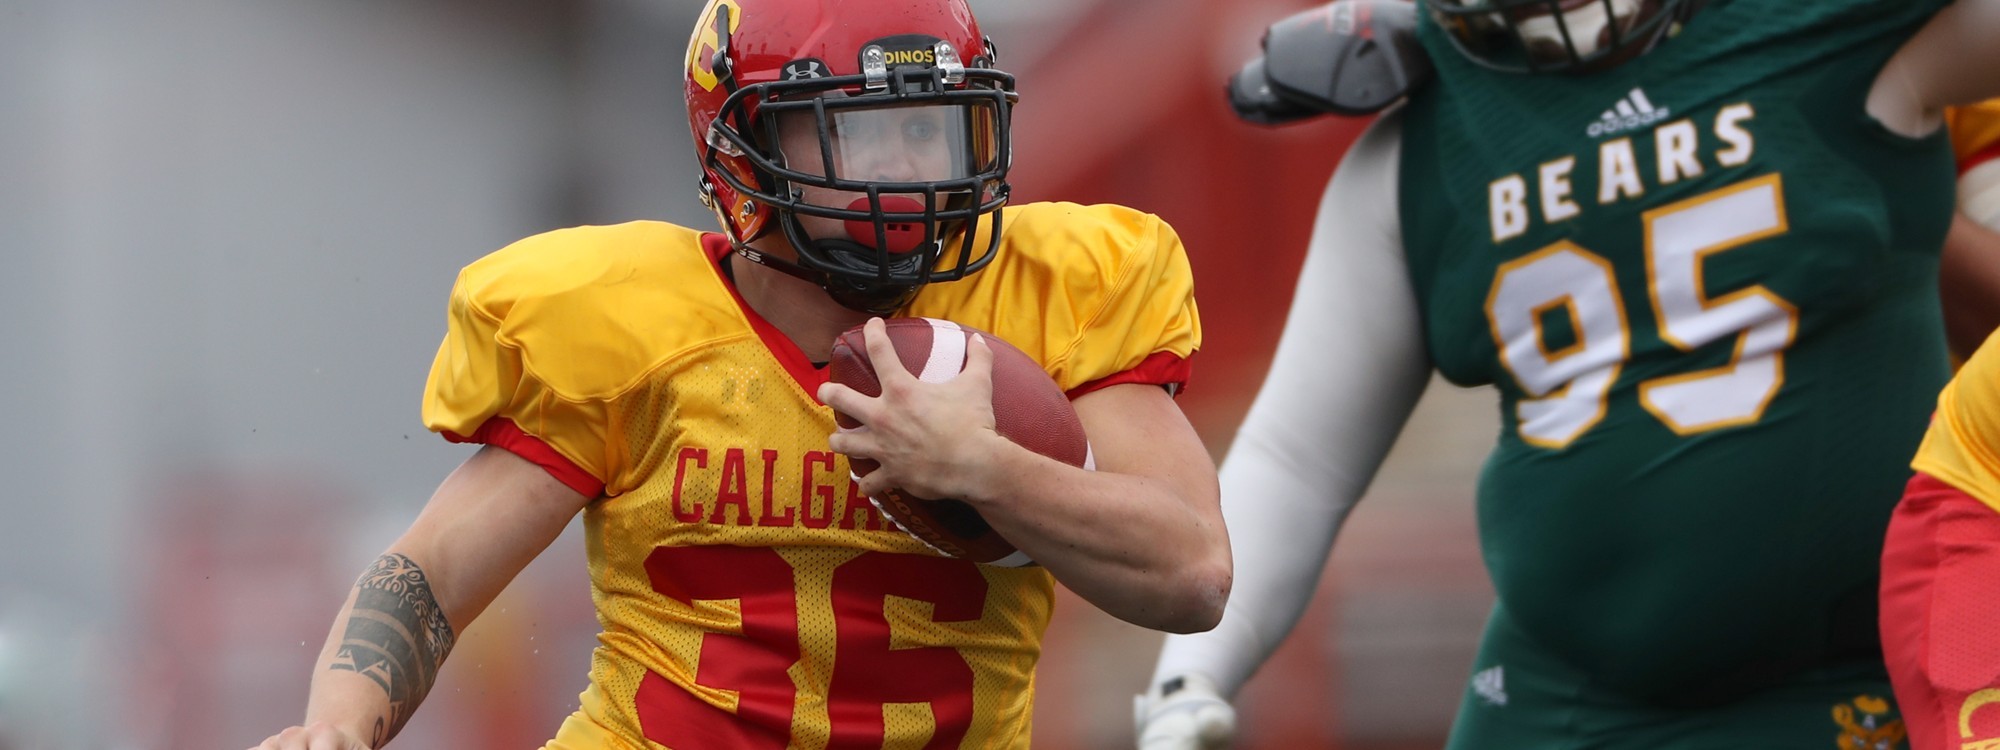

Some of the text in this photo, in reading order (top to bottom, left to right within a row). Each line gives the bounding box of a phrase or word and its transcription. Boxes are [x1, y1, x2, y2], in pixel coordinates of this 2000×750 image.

[884, 50, 934, 65] DINOS
[1489, 102, 1755, 242] BEARS
[1484, 172, 1799, 450] 95
[672, 447, 902, 532] CALGA
[632, 543, 989, 750] 36
